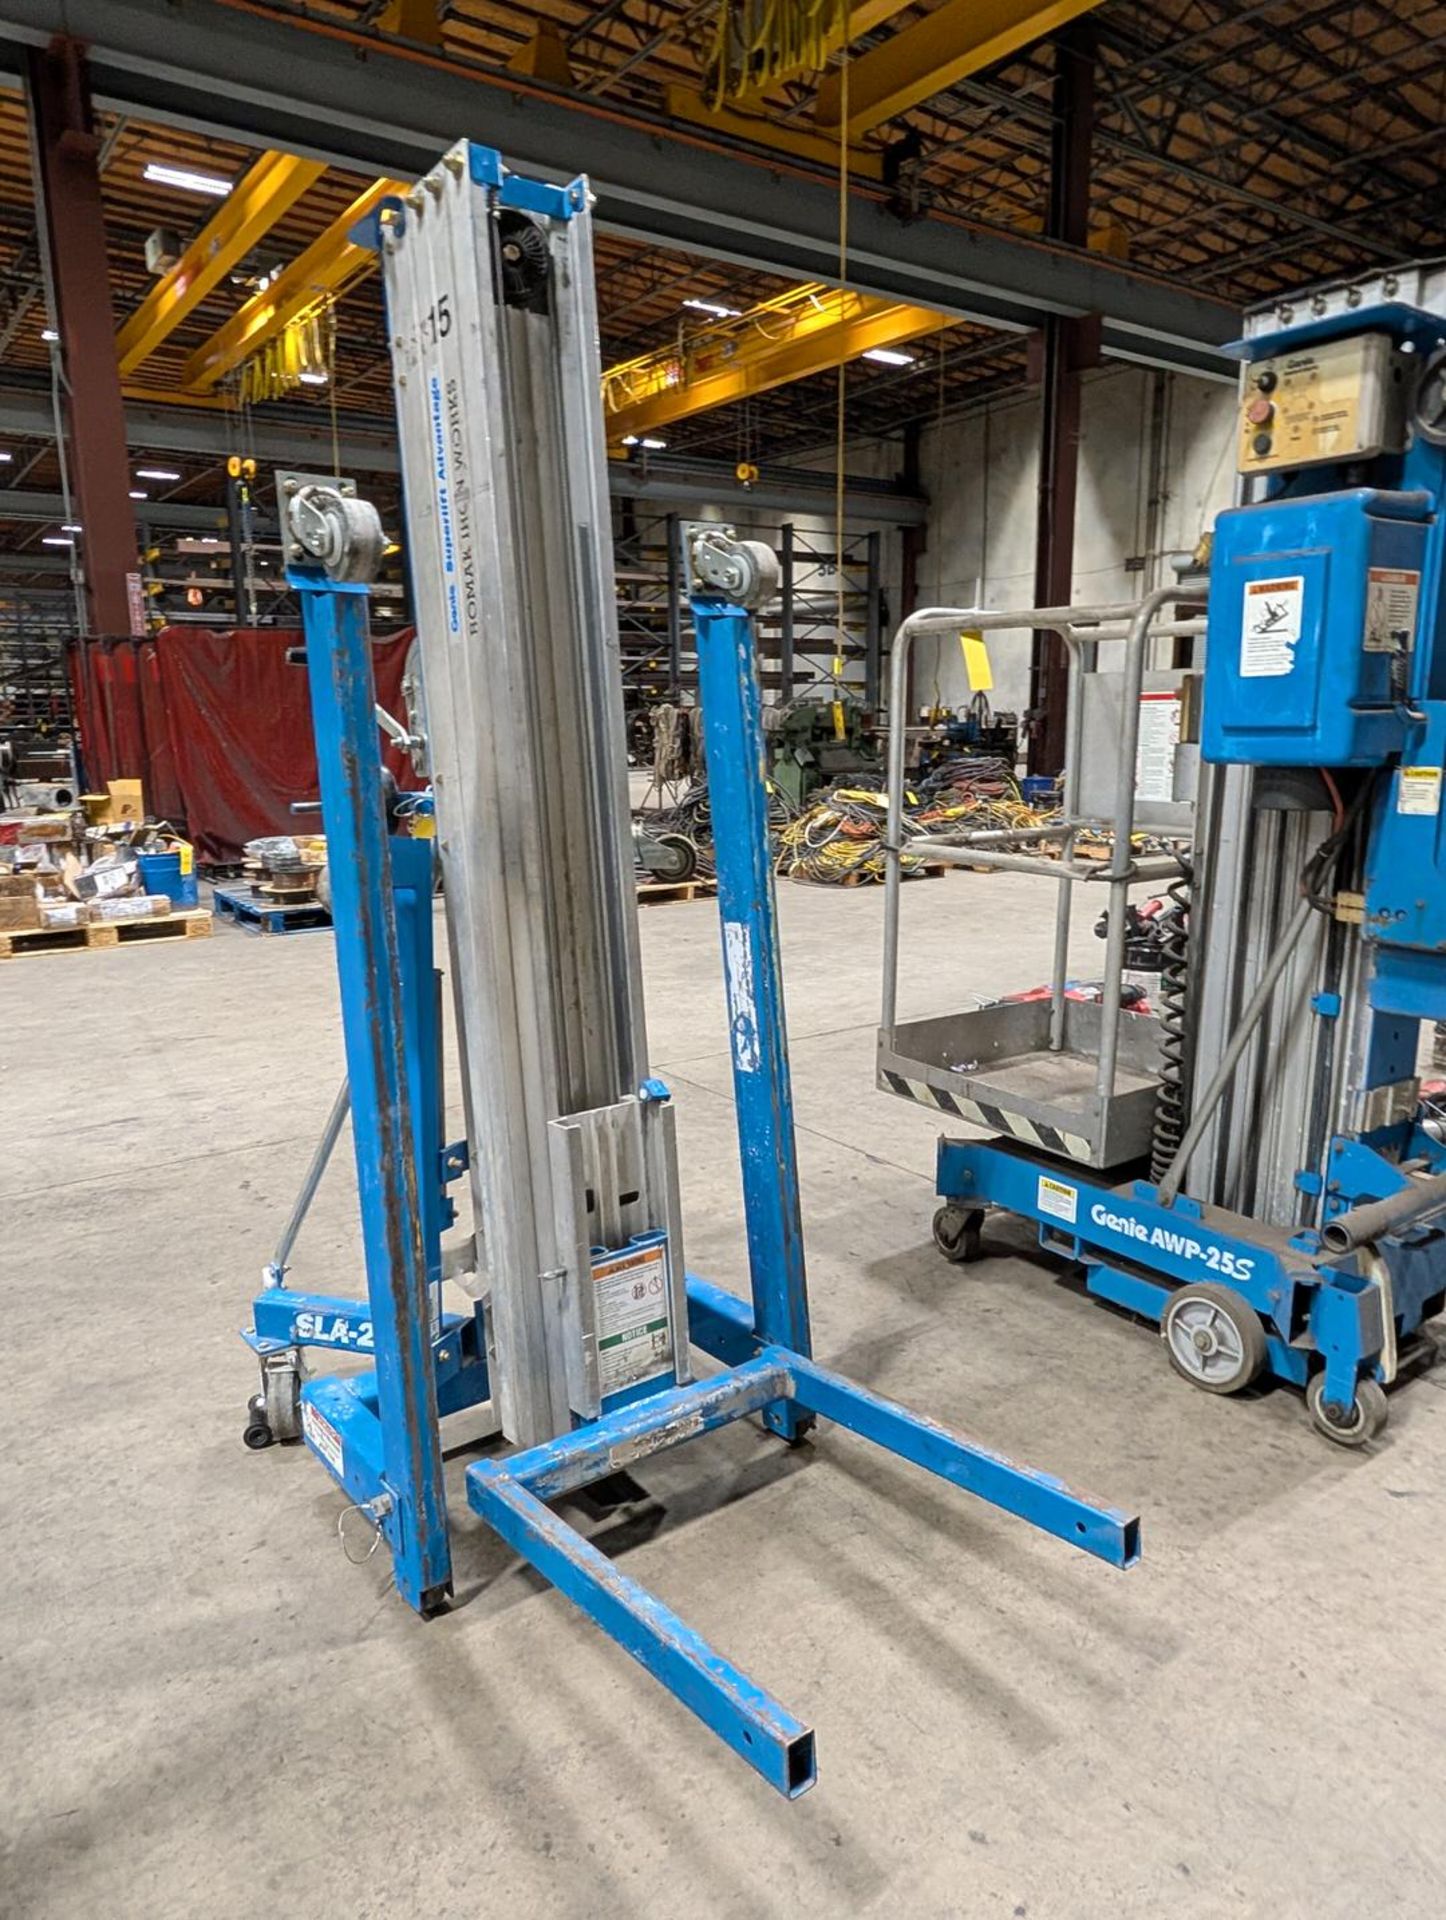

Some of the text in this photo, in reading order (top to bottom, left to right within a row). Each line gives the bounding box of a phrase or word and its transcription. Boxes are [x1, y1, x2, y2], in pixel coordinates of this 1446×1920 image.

[431, 377, 459, 632] Genie Superlift Advantage
[1091, 1204, 1150, 1242] Genie
[1151, 1227, 1256, 1281] AWP-25S
[621, 1325, 649, 1343] NOTICE
